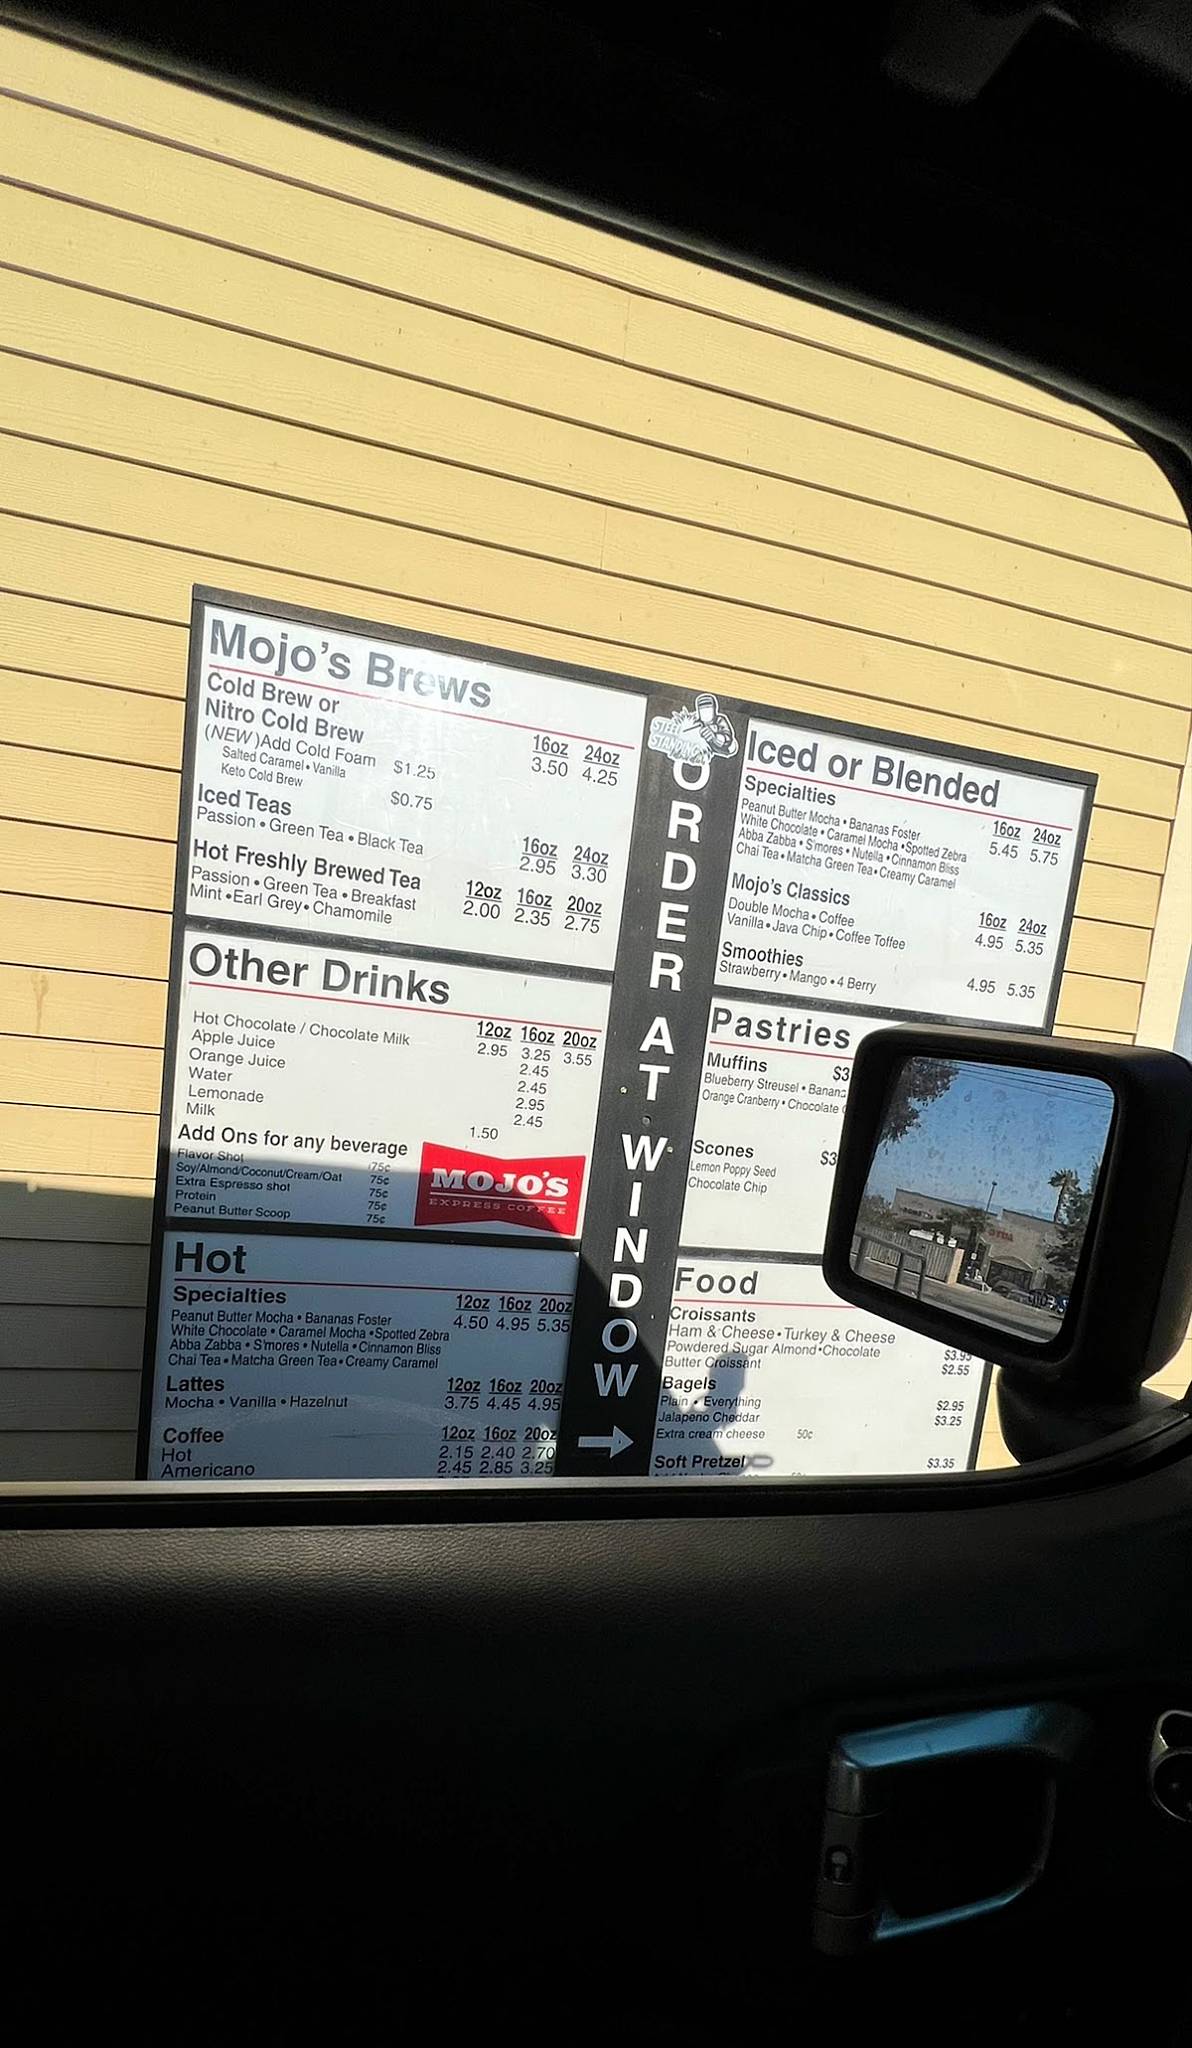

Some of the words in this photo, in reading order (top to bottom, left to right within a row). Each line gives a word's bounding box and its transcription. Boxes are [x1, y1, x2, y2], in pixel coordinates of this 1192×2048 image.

[210, 618, 350, 679] Mojo's
[366, 651, 491, 708] Brews
[207, 671, 254, 698] Cold
[261, 681, 312, 708] Brew
[318, 697, 339, 713] or
[205, 696, 254, 723] Nitro
[261, 707, 307, 733] Cold
[314, 717, 364, 743] Brew
[533, 734, 568, 755] 16oz
[584, 744, 619, 765] 24oz
[221, 744, 256, 762] Salted
[259, 751, 304, 770] Caramel
[312, 761, 345, 778] Vanilla
[393, 759, 435, 779] $1.25
[531, 756, 568, 777] 3.50
[581, 766, 617, 786] 4.25
[747, 729, 818, 772] Iced
[827, 754, 862, 780] or
[871, 754, 1000, 807] Blended
[220, 762, 245, 777] Keto
[248, 767, 273, 782] Cold
[275, 771, 303, 786] Brew
[198, 783, 240, 807] Iced
[245, 790, 291, 815] Teas
[390, 790, 432, 810] $0.75
[744, 774, 835, 805] Specialties
[740, 797, 775, 815] Peanut
[777, 804, 807, 820] Butter
[808, 809, 840, 826] Mocha
[848, 816, 889, 835] Bananas
[891, 824, 920, 840] Foster
[988, 841, 1018, 859] 5.45
[1029, 848, 1058, 865] 5.75
[193, 838, 228, 861] Hot
[235, 845, 307, 877] Freshly
[313, 856, 384, 884] Brewed
[389, 868, 420, 890] Tea
[648, 759, 711, 992] ORDER
[191, 864, 249, 886] Passion
[263, 875, 308, 895] Green
[312, 882, 337, 899] Tea
[350, 888, 416, 910] Breakfast
[731, 872, 782, 896] Mojo's
[786, 881, 850, 906] Classics
[190, 882, 221, 900] Mint
[232, 888, 262, 905] Earl
[267, 893, 302, 914] Grey
[312, 900, 392, 924] Chamomile
[727, 911, 763, 929] Vanilla
[771, 919, 798, 934] Java
[801, 923, 827, 940] Chip
[835, 928, 870, 944] Coffee
[873, 933, 905, 950] Toffee
[721, 940, 803, 967] Smoothies
[189, 942, 308, 987] Other
[322, 958, 449, 1004] Drinks
[718, 959, 781, 982] Strawberry
[788, 969, 827, 987] Mango
[836, 976, 844, 987] 4
[846, 976, 876, 994] Berry
[966, 977, 995, 993] 4.95
[1006, 982, 1035, 999] 5.35
[193, 1009, 218, 1025] Hot
[223, 1013, 296, 1033] Chocolate
[309, 1022, 379, 1042] Chocolate
[382, 1031, 409, 1045] Milk
[477, 1020, 511, 1038] 12oz
[521, 1025, 555, 1043] 16oz
[562, 1030, 597, 1048] 20oz
[710, 1006, 850, 1049] Pastries
[190, 1028, 233, 1046] Apple
[237, 1033, 275, 1049] Juice
[188, 1046, 243, 1066] Orange
[247, 1053, 285, 1068] Juice
[477, 1041, 507, 1057] 2.95
[521, 1046, 550, 1061] 3.25
[563, 1051, 592, 1066] 3.55
[638, 1016, 675, 1101] AT
[706, 1051, 767, 1072] Muffins
[188, 1065, 232, 1081] Water
[519, 1062, 548, 1077] 2.45
[703, 1071, 754, 1091] Blueberry
[756, 1077, 799, 1092] Streusel
[188, 1083, 264, 1103] Lemonade
[186, 1101, 215, 1116] Milk
[177, 1123, 214, 1141] Add
[221, 1126, 257, 1144] Ons
[263, 1129, 288, 1146] for
[293, 1136, 325, 1153] any
[330, 1135, 407, 1159] beverage
[469, 1126, 498, 1140] 1.50
[693, 1139, 753, 1158] Scones
[689, 1159, 720, 1172] Lemon
[722, 1162, 751, 1178] Poppy
[752, 1164, 776, 1177] Seed
[430, 1167, 569, 1198] MOJO'S
[175, 1188, 216, 1202] Protein
[429, 1198, 501, 1210] EXPRESS
[508, 1203, 566, 1215] COFFEE
[174, 1241, 247, 1274] Hot
[593, 1133, 669, 1398] WINDOW
[674, 1266, 758, 1294] Food
[172, 1285, 286, 1304] Specialties
[169, 1306, 213, 1322] Peanut
[216, 1309, 252, 1322] Butter
[255, 1310, 293, 1324] Mocha
[302, 1311, 353, 1325] Bananas
[356, 1313, 392, 1325] Foster
[667, 1304, 755, 1322] Croissants
[171, 1323, 208, 1339] White
[209, 1323, 268, 1339] Chocolate
[278, 1324, 326, 1337] Caramel
[329, 1326, 365, 1338] Mocha
[374, 1327, 416, 1341] Spotted
[418, 1328, 449, 1341] Zebra
[668, 1323, 702, 1337] Ham
[706, 1324, 716, 1337] &
[721, 1324, 774, 1339] Cheese
[784, 1326, 827, 1343] Turkey
[830, 1328, 839, 1341] &
[845, 1328, 895, 1344] Cheese
[666, 1339, 730, 1356] Powdered
[729, 1341, 768, 1356] Sugar
[771, 1342, 817, 1355] Almond
[822, 1344, 880, 1357] Chocolate
[664, 1355, 701, 1367] Butter
[704, 1355, 760, 1368] Croissant
[941, 1363, 969, 1375] $2.55
[166, 1375, 224, 1391] Lattes
[661, 1376, 717, 1394] Bagels
[442, 1395, 479, 1409] 3.75
[484, 1396, 520, 1410] 4.45
[526, 1396, 563, 1411] 4.95
[936, 1399, 964, 1411] $2.95
[712, 1411, 760, 1422] Cheddar
[934, 1415, 961, 1426] $3.25
[163, 1427, 224, 1443] Coffee
[161, 1447, 191, 1462] Hot
[653, 1454, 687, 1468] Soft
[691, 1454, 747, 1469] Pretzel
[926, 1457, 954, 1468] $3.35
[160, 1462, 254, 1478] Americano
